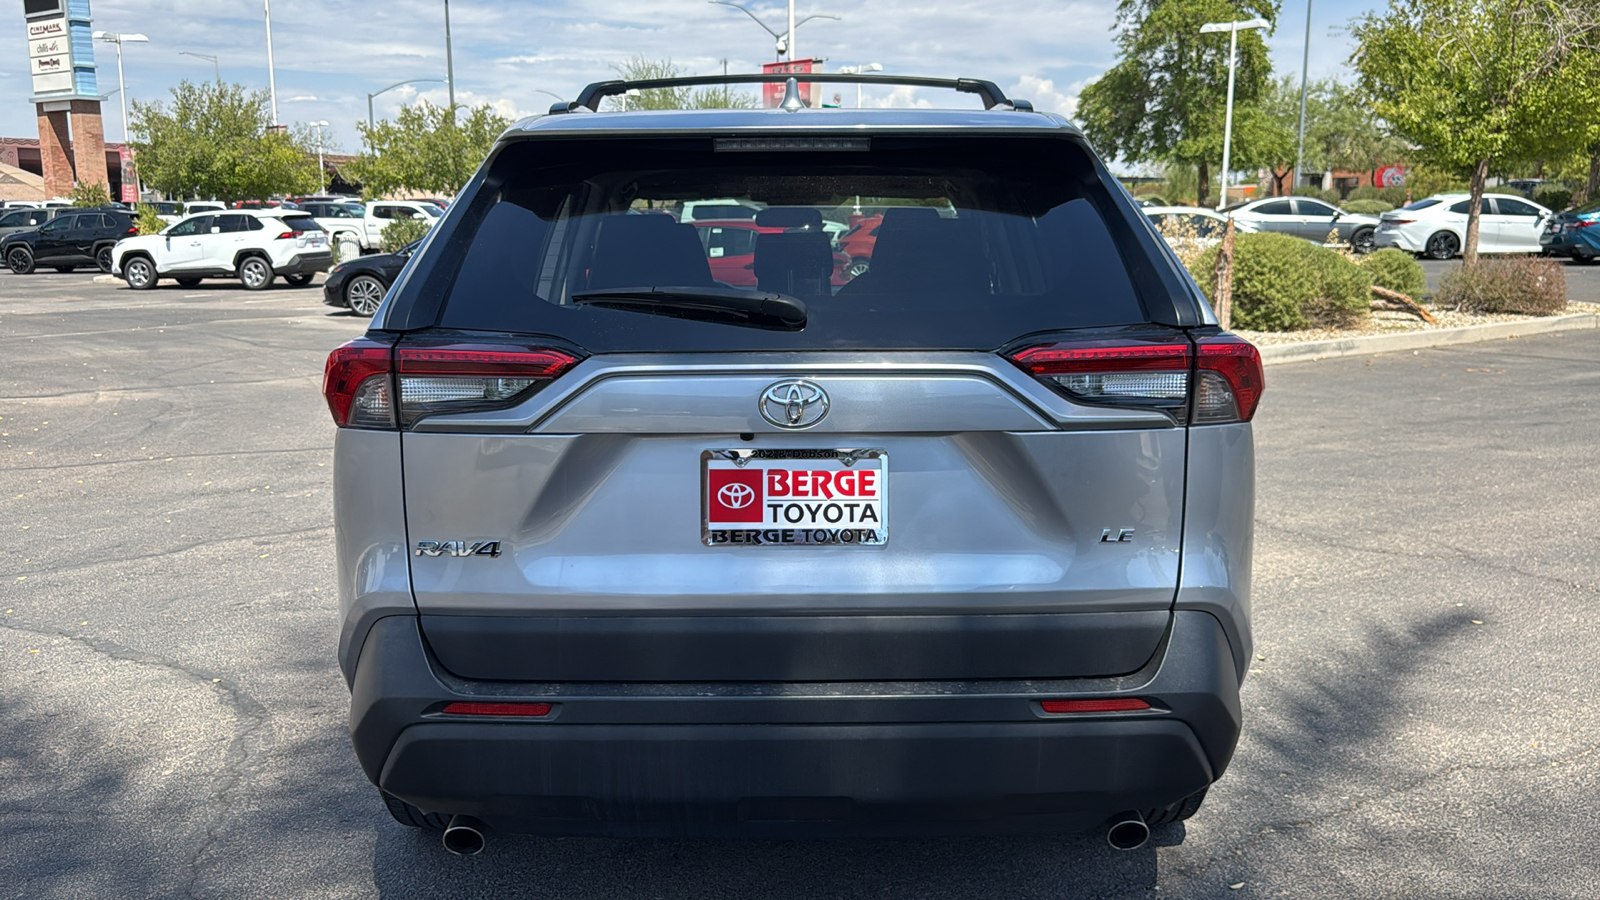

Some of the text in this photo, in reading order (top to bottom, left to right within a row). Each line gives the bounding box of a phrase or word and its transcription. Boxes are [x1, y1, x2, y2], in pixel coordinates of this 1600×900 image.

[751, 449, 839, 458] 202 & Dobson
[767, 469, 876, 500] BERGE
[767, 503, 879, 523] TOYOTA
[711, 528, 879, 544] BERGE TOYOTA
[1098, 528, 1136, 543] LE
[414, 540, 502, 557] RAV4
